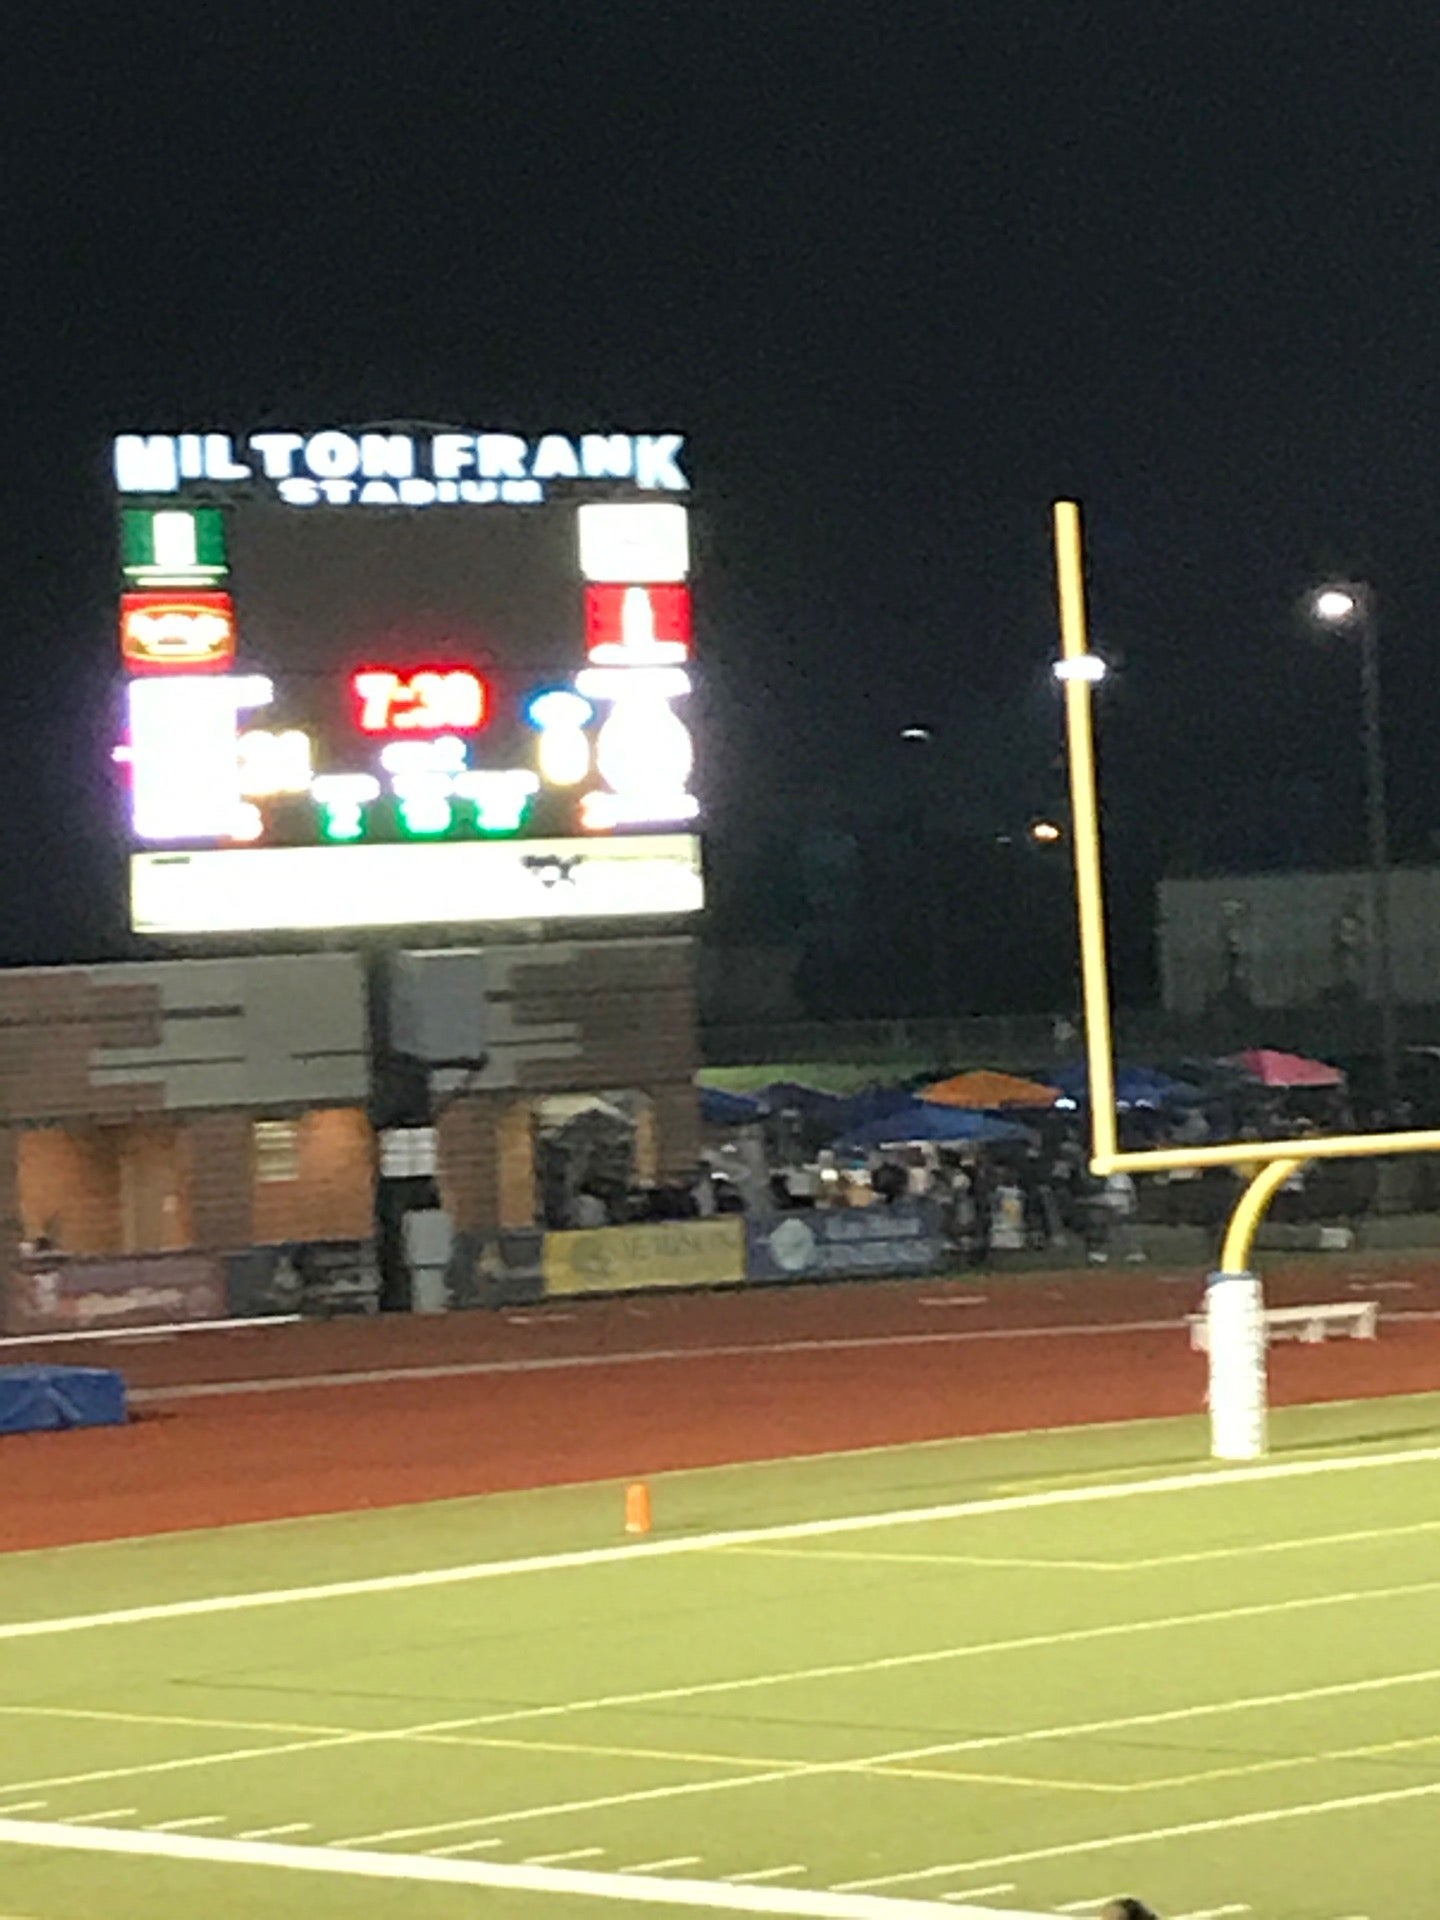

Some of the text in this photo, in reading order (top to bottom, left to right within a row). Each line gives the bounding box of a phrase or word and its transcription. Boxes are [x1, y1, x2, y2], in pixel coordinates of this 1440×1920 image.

[114, 431, 690, 492] MILTON FRANK
[277, 479, 544, 504] STADIUM
